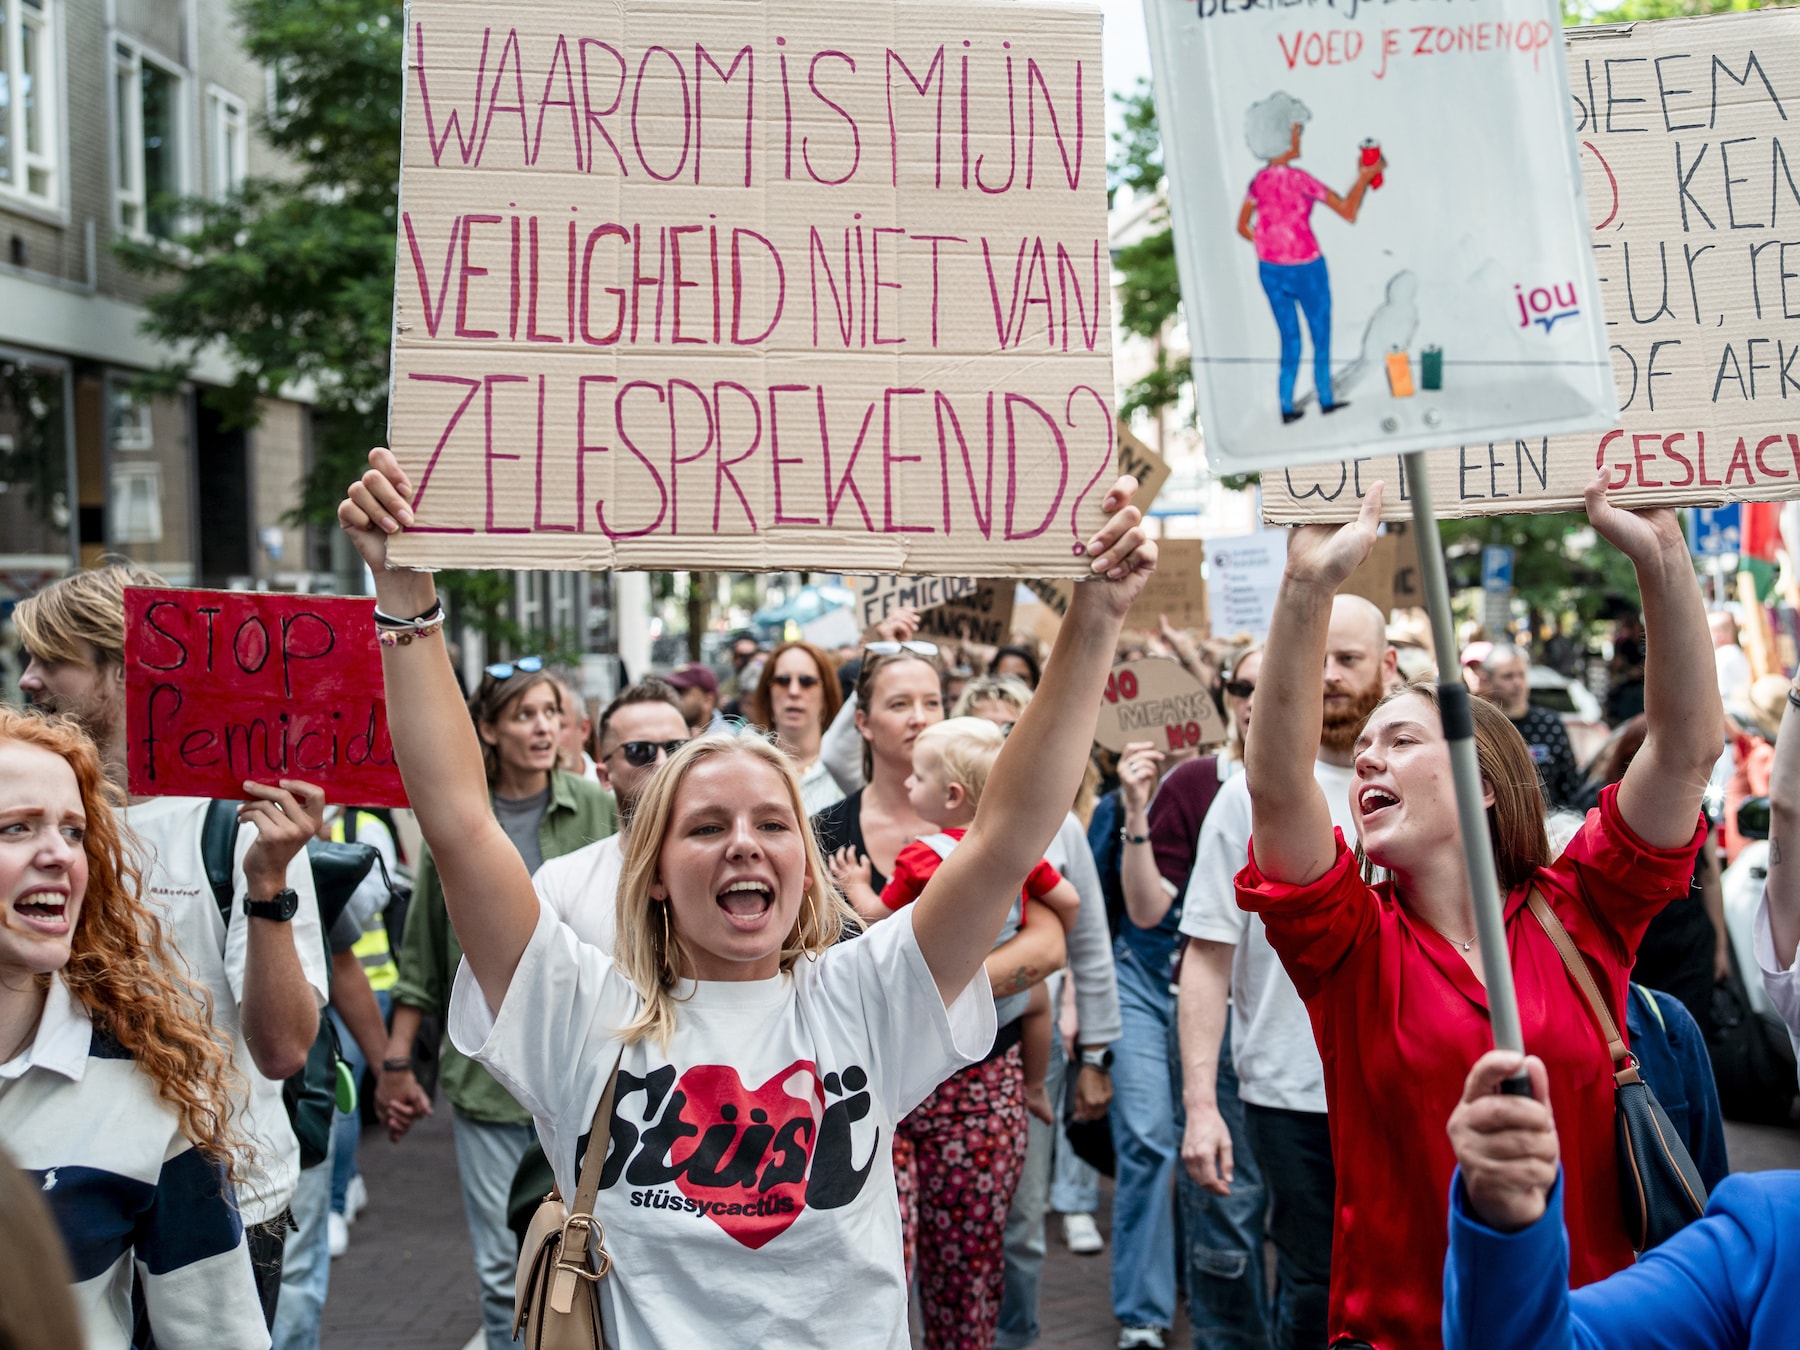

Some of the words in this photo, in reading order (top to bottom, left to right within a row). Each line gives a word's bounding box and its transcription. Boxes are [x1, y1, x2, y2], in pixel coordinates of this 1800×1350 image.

[1278, 30, 1363, 69] VOED
[416, 22, 753, 188] WAAROM
[982, 236, 1099, 352] VAN
[1514, 282, 1577, 328] jou
[401, 372, 1112, 556] ZELFSPREKEND?
[1596, 429, 1800, 490] GESLAC
[142, 683, 399, 781] femicid
[1117, 690, 1212, 732] MEANS
[1166, 720, 1201, 751] NO
